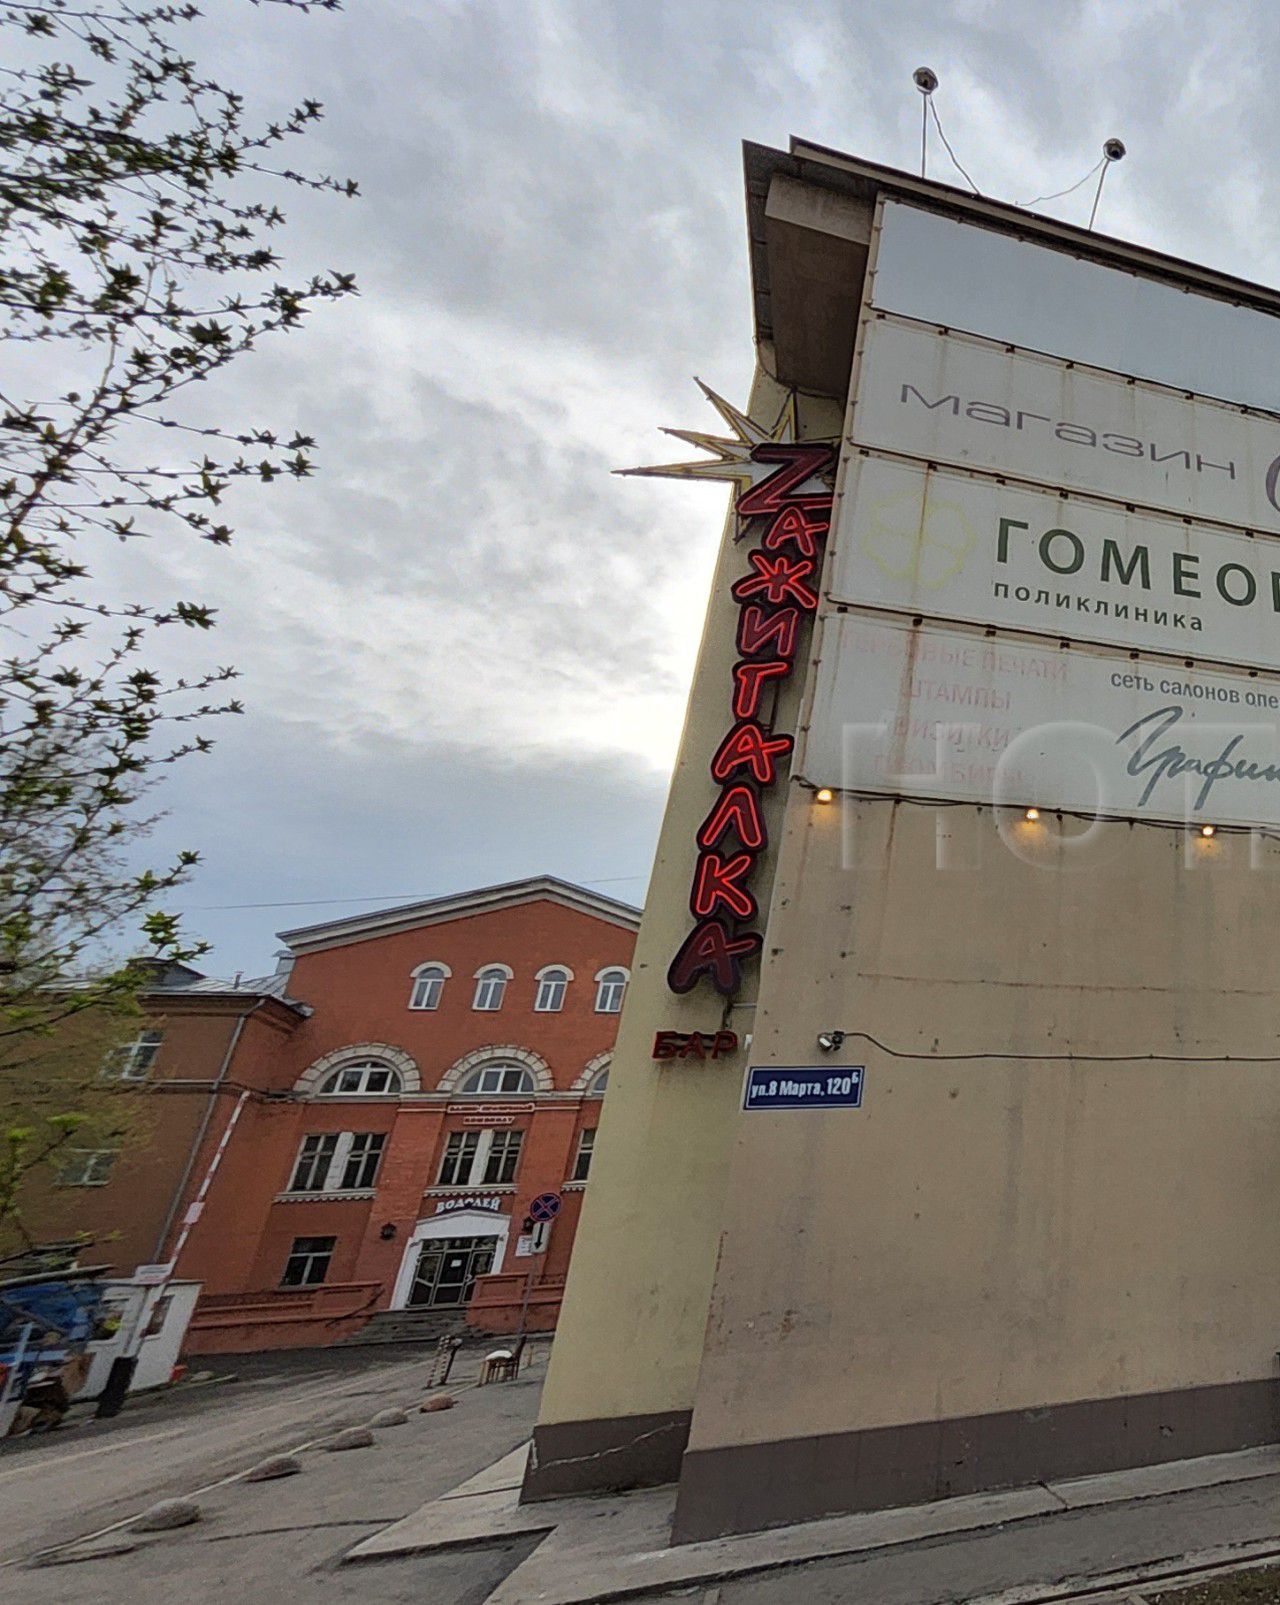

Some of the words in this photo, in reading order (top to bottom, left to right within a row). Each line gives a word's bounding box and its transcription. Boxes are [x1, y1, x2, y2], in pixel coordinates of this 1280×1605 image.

[900, 383, 1236, 481] магазин
[993, 582, 1204, 632] поликлиника
[1110, 672, 1155, 692] сеть
[1159, 679, 1240, 704] салонов
[652, 1030, 738, 1059] БАР
